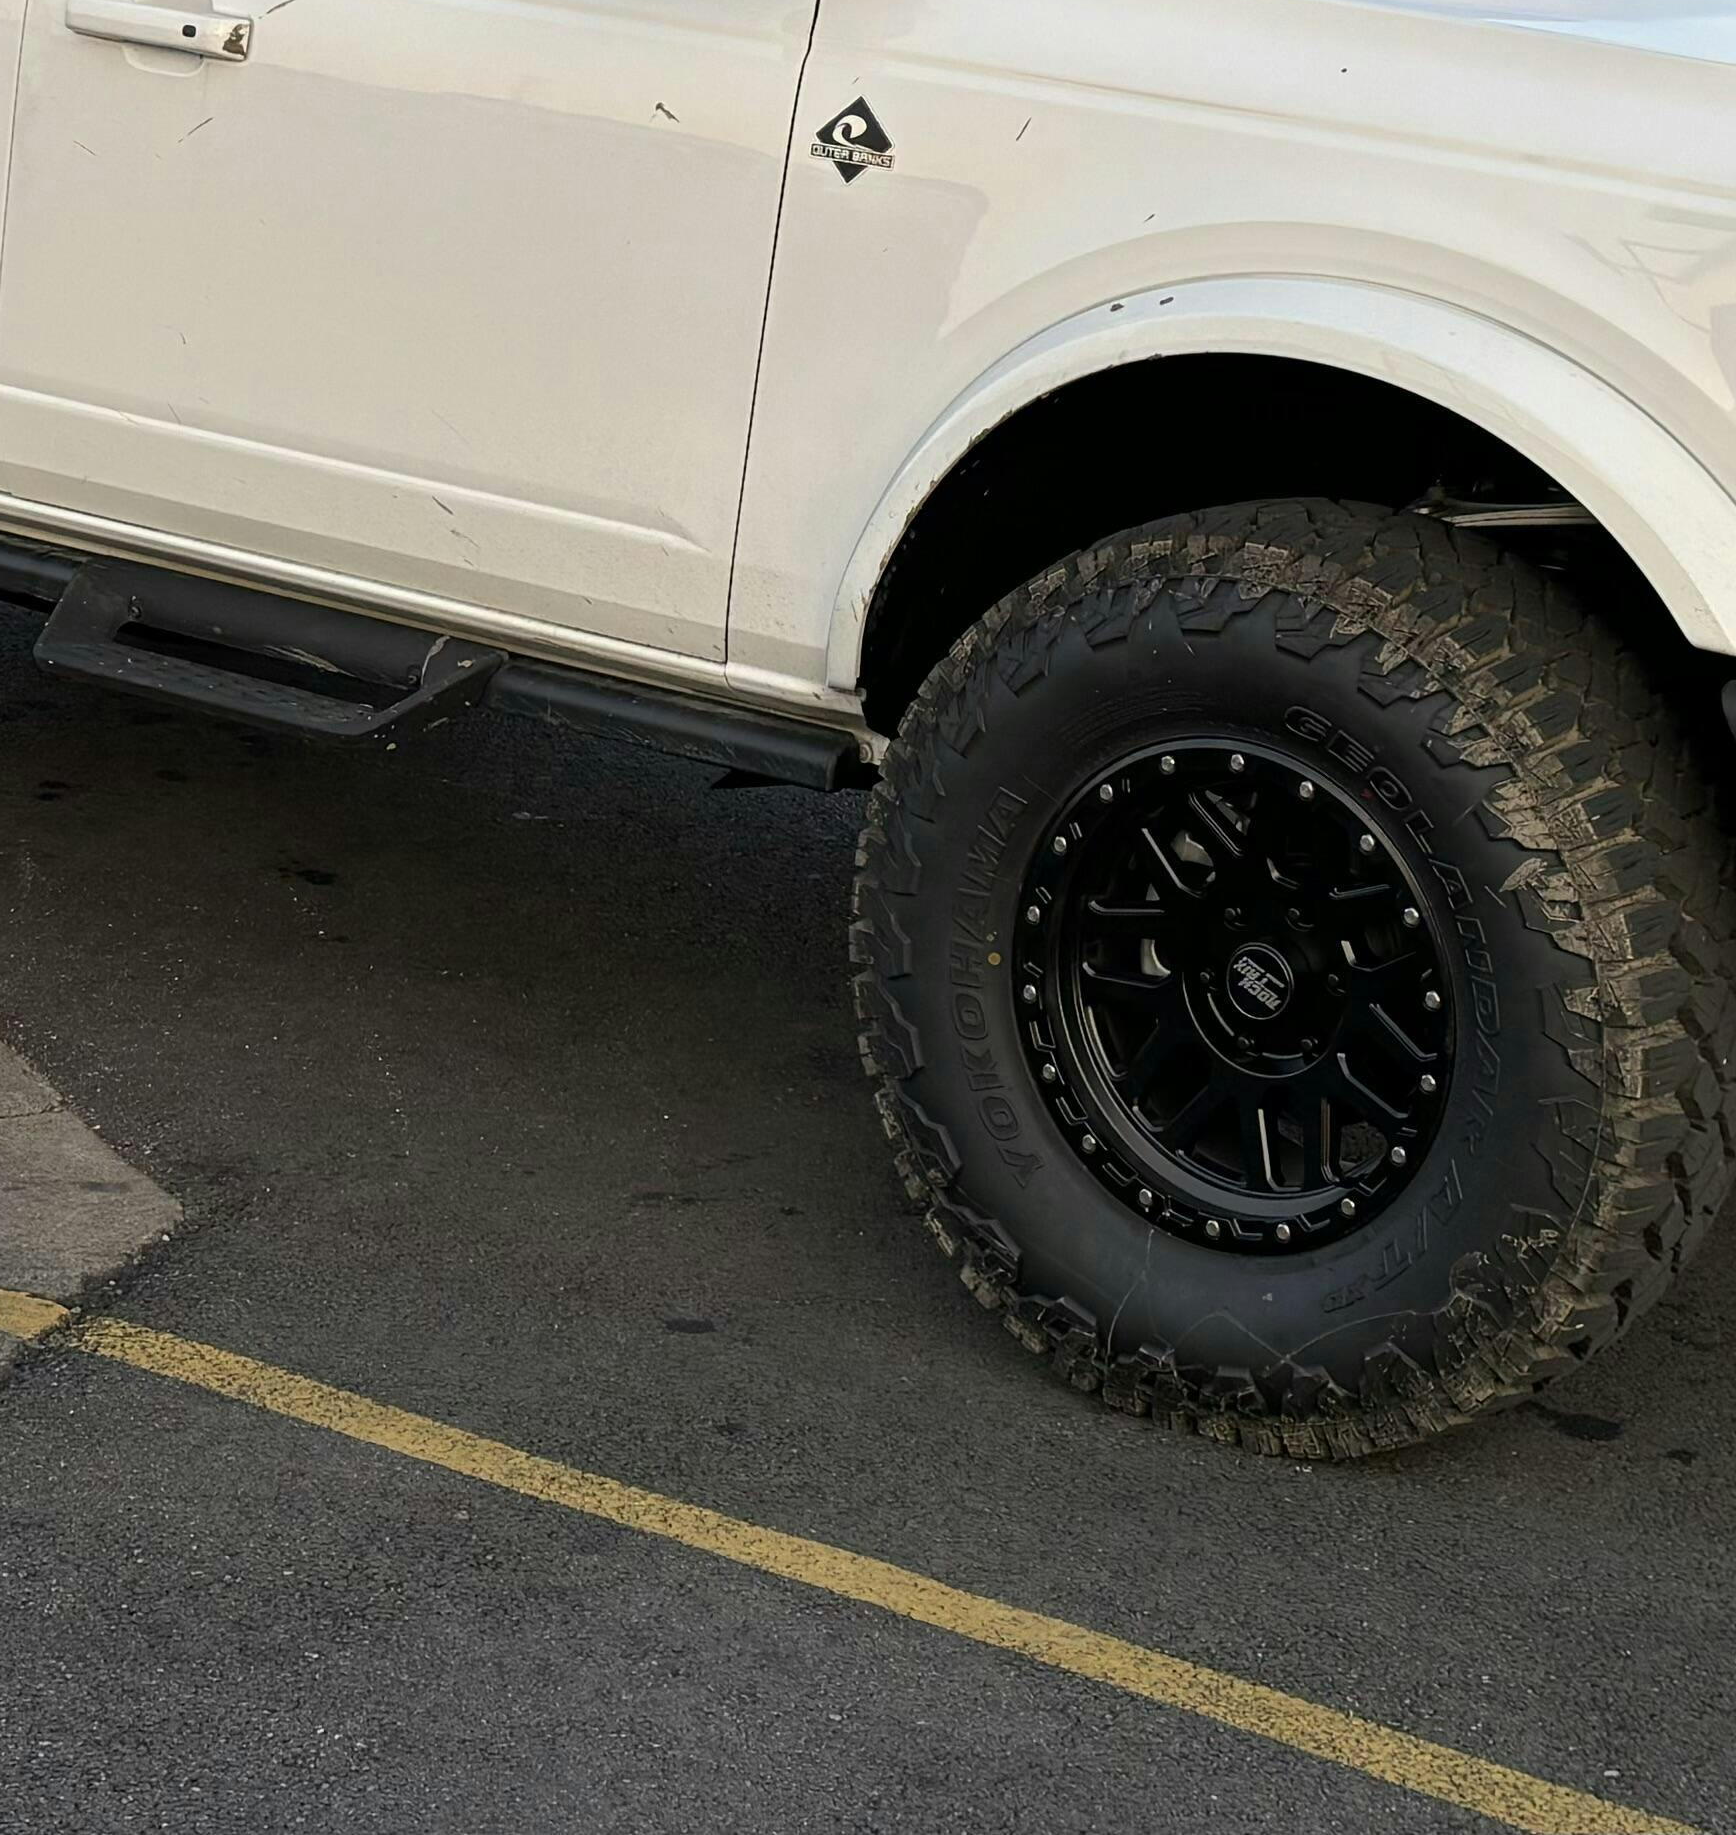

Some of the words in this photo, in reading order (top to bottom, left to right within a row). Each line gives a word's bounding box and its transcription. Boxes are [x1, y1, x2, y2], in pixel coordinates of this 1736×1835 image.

[812, 145, 850, 160] OUTER
[852, 150, 891, 168] BANKS
[948, 785, 1047, 1191] YOKOHAMA
